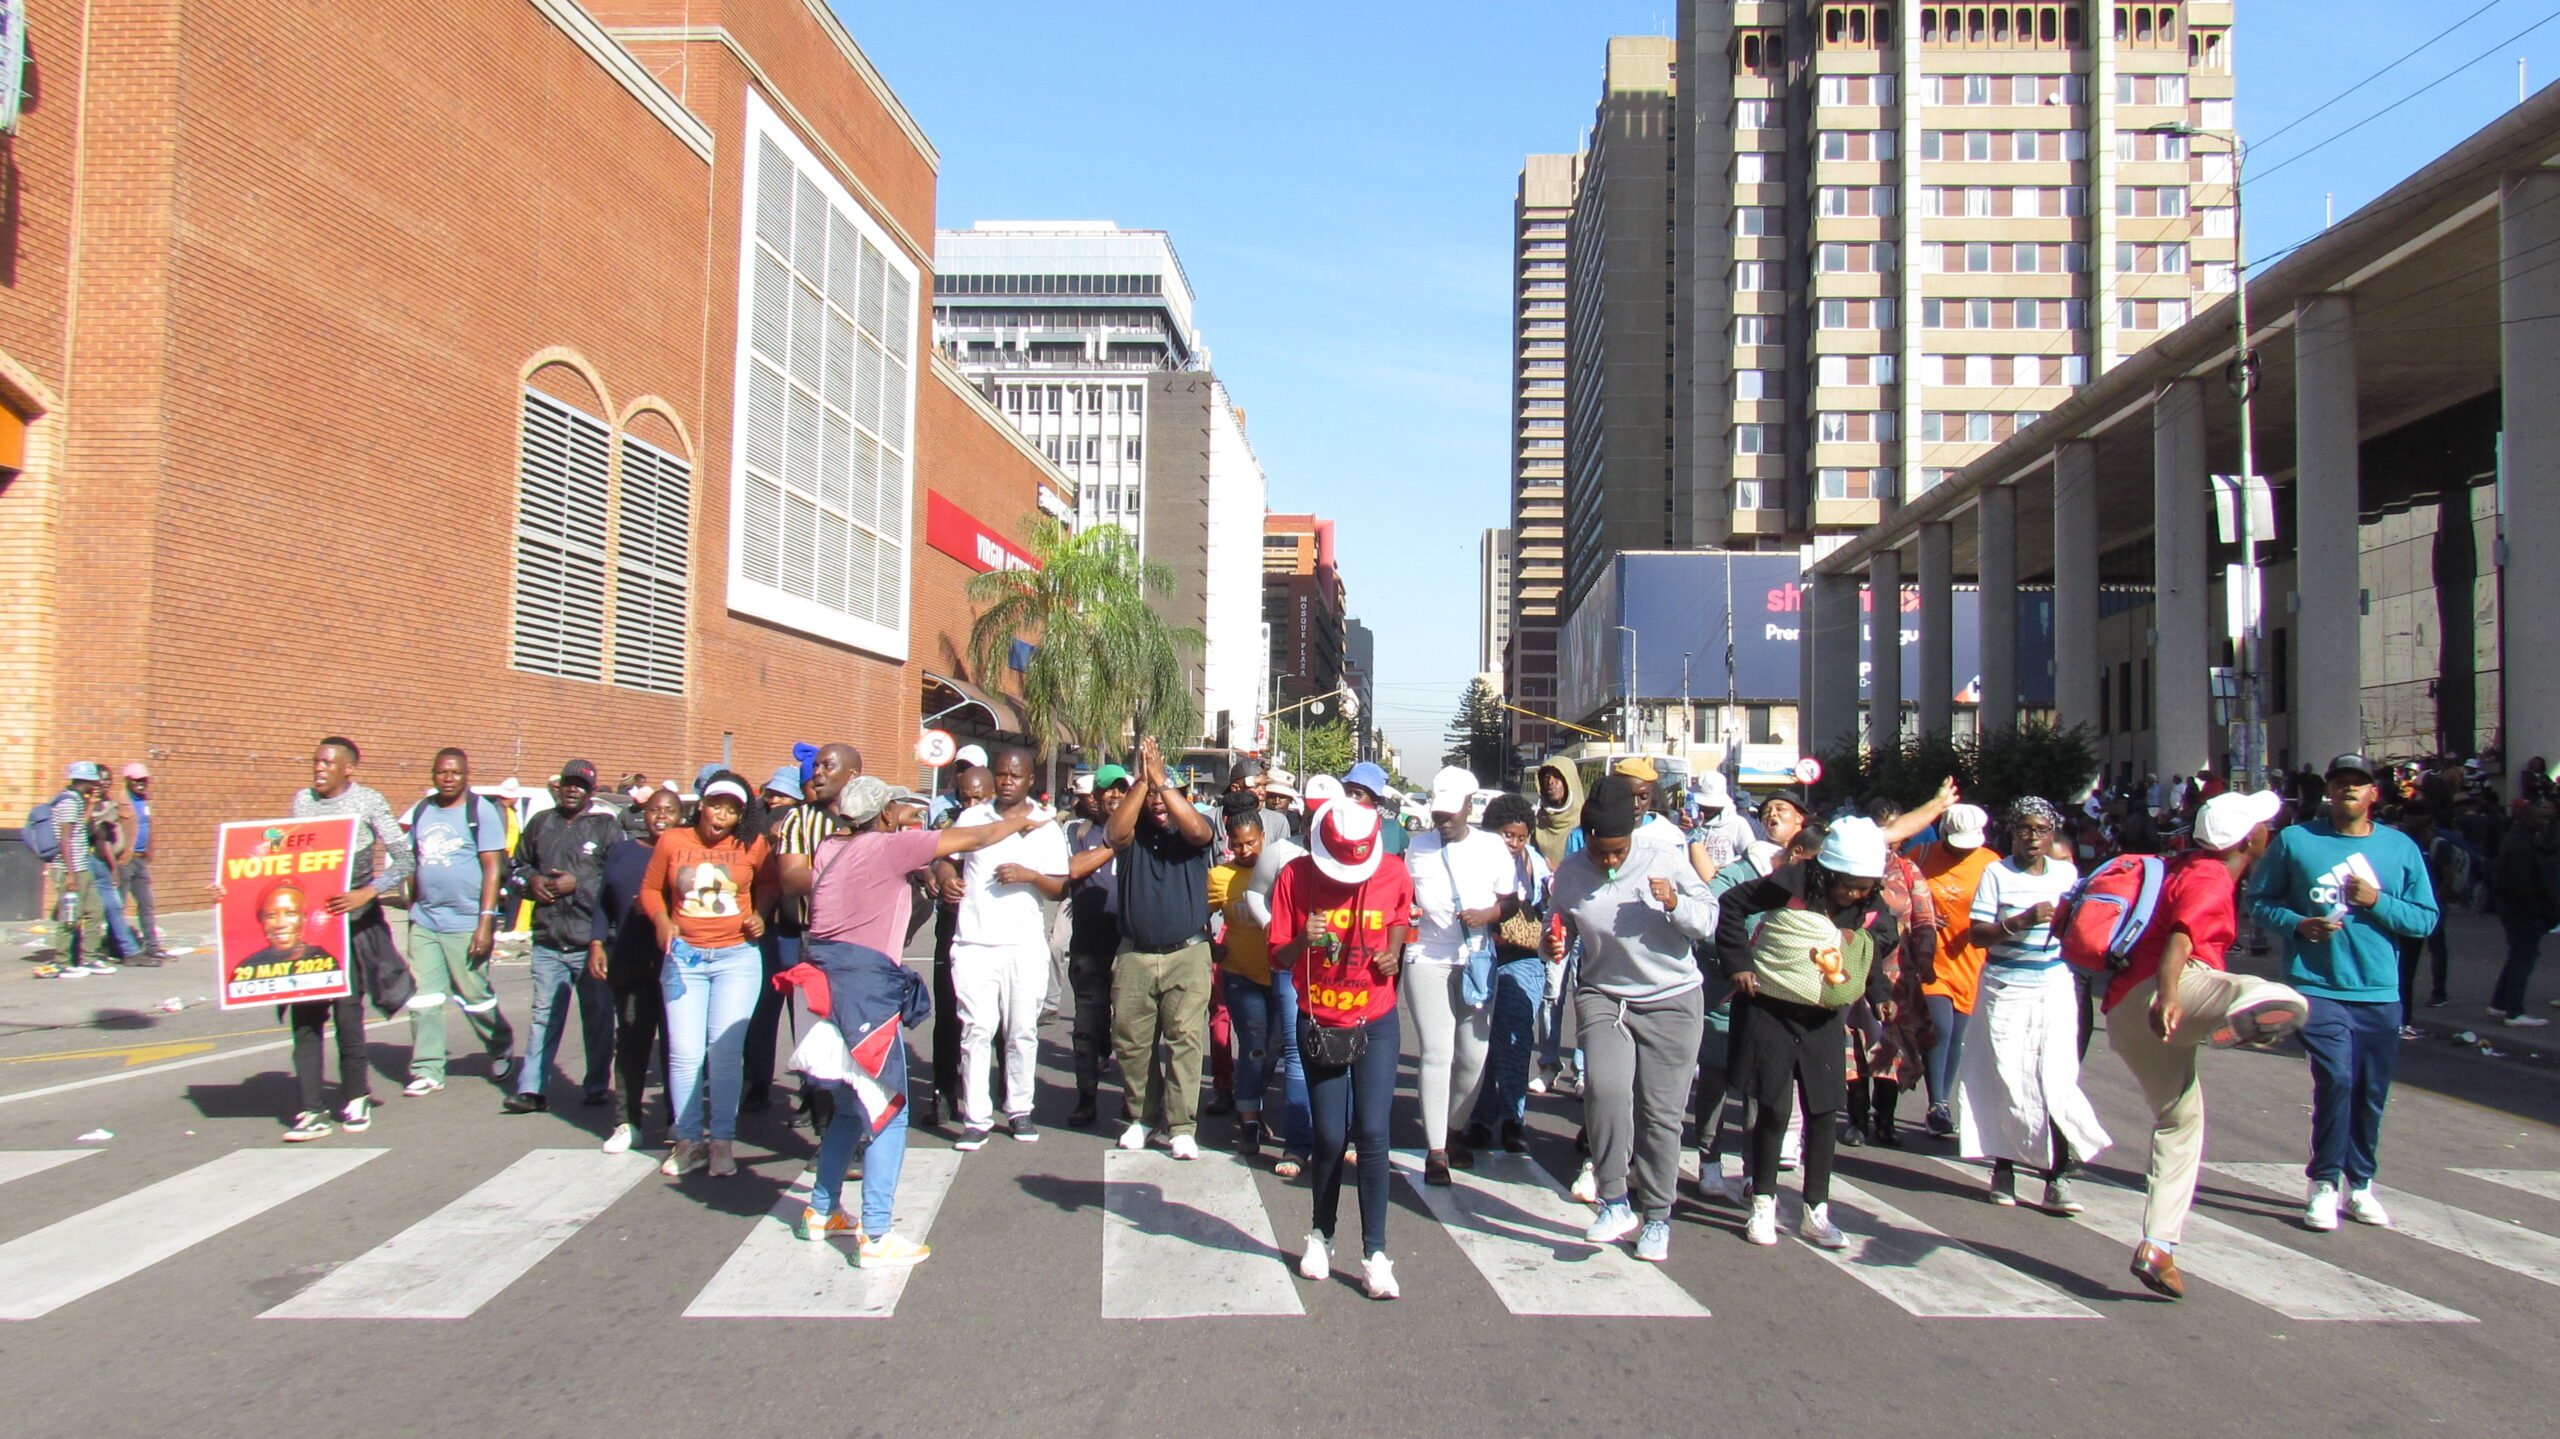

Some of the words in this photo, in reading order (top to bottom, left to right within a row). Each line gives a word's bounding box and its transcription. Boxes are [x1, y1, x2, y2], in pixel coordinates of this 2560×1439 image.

[976, 532, 1004, 571] VIRGIN
[286, 833, 315, 848] EFF
[227, 853, 293, 880] VOTE
[298, 849, 345, 873] EFF
[1316, 909, 1382, 930] VOTE
[234, 966, 254, 982] 29
[256, 962, 292, 979] MAY
[295, 957, 334, 975] 2024
[235, 979, 276, 995] VOTE
[1310, 983, 1368, 1011] 2024
